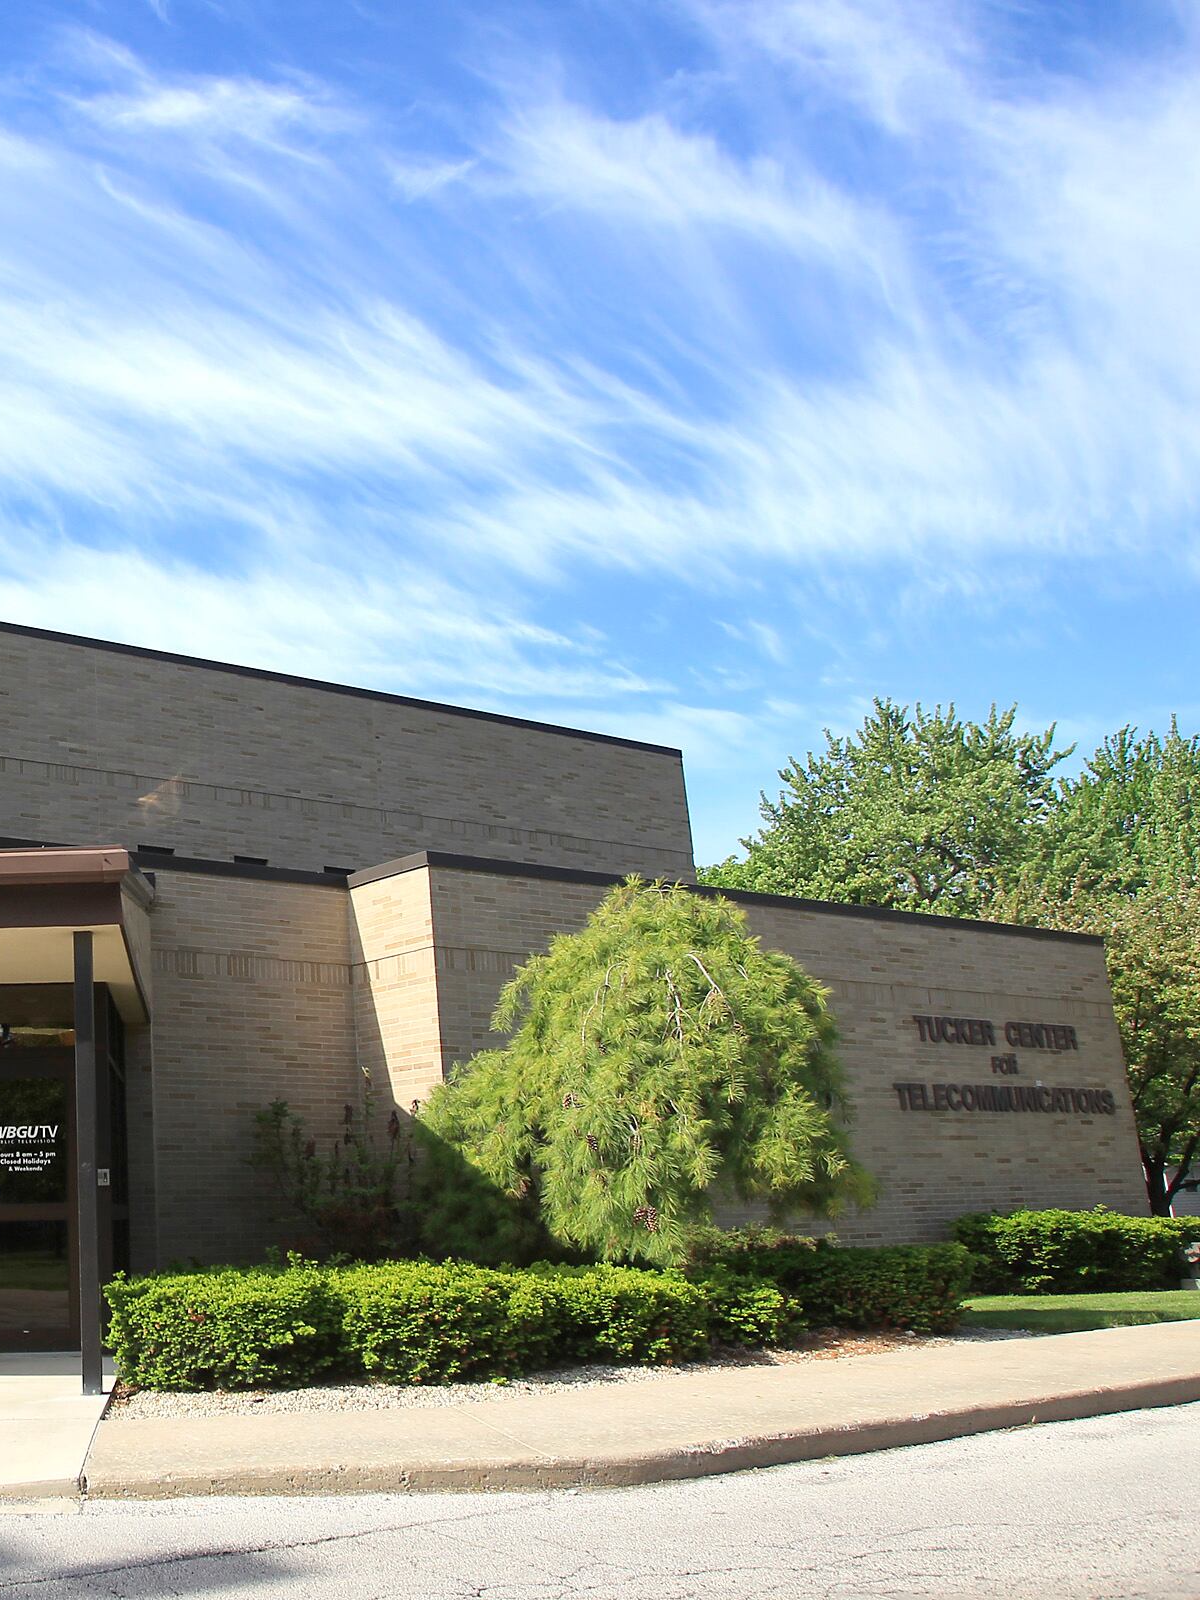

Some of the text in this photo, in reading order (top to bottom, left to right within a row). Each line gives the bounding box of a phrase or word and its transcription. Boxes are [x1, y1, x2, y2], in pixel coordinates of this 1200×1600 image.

[913, 1015, 1078, 1050] TUCKER CENTER
[991, 1056, 1019, 1075] FOR
[893, 1083, 1117, 1115] TELECOMMUNICATIONS
[22, 1158, 51, 1166] Holidays
